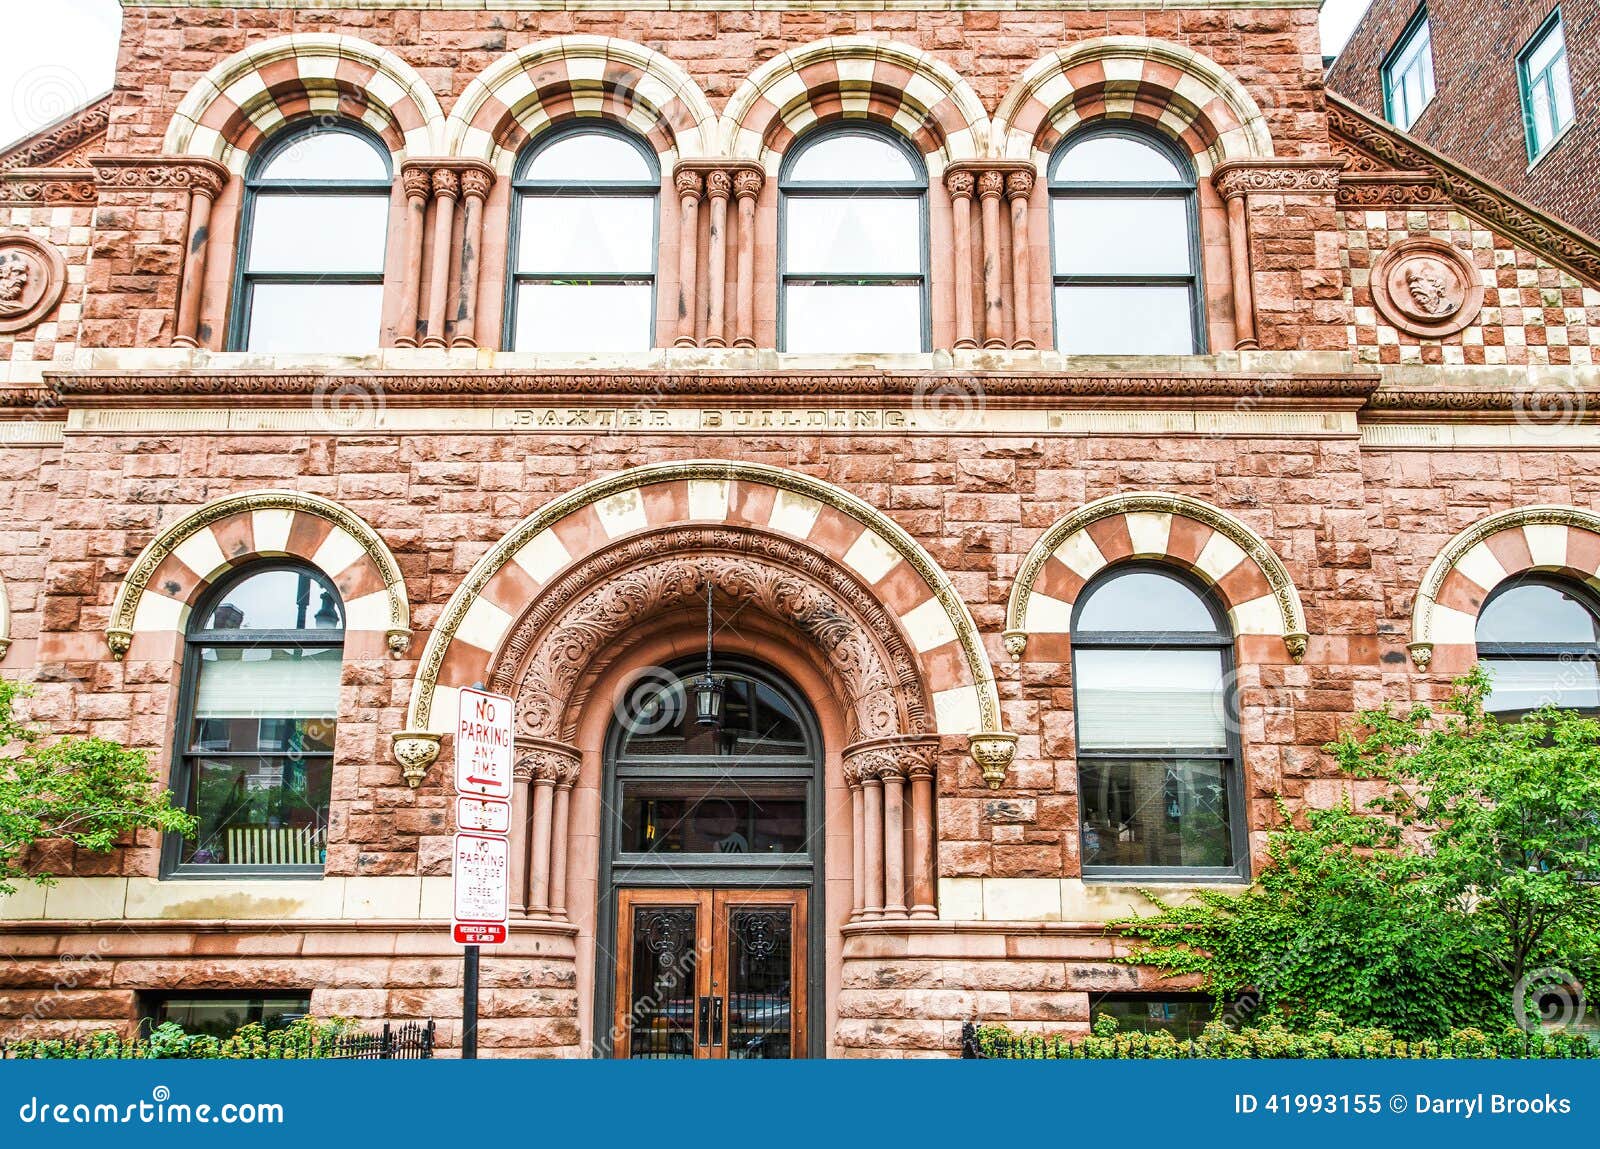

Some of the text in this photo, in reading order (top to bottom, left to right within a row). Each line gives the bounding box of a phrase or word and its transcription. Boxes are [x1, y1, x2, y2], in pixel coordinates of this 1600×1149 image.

[513, 410, 672, 427] BAXTER
[476, 701, 495, 722] NO
[461, 720, 508, 747] PARKING
[474, 746, 495, 761] ANY
[472, 760, 497, 776] TIME
[475, 841, 489, 853] NO
[460, 852, 504, 867] PARKING
